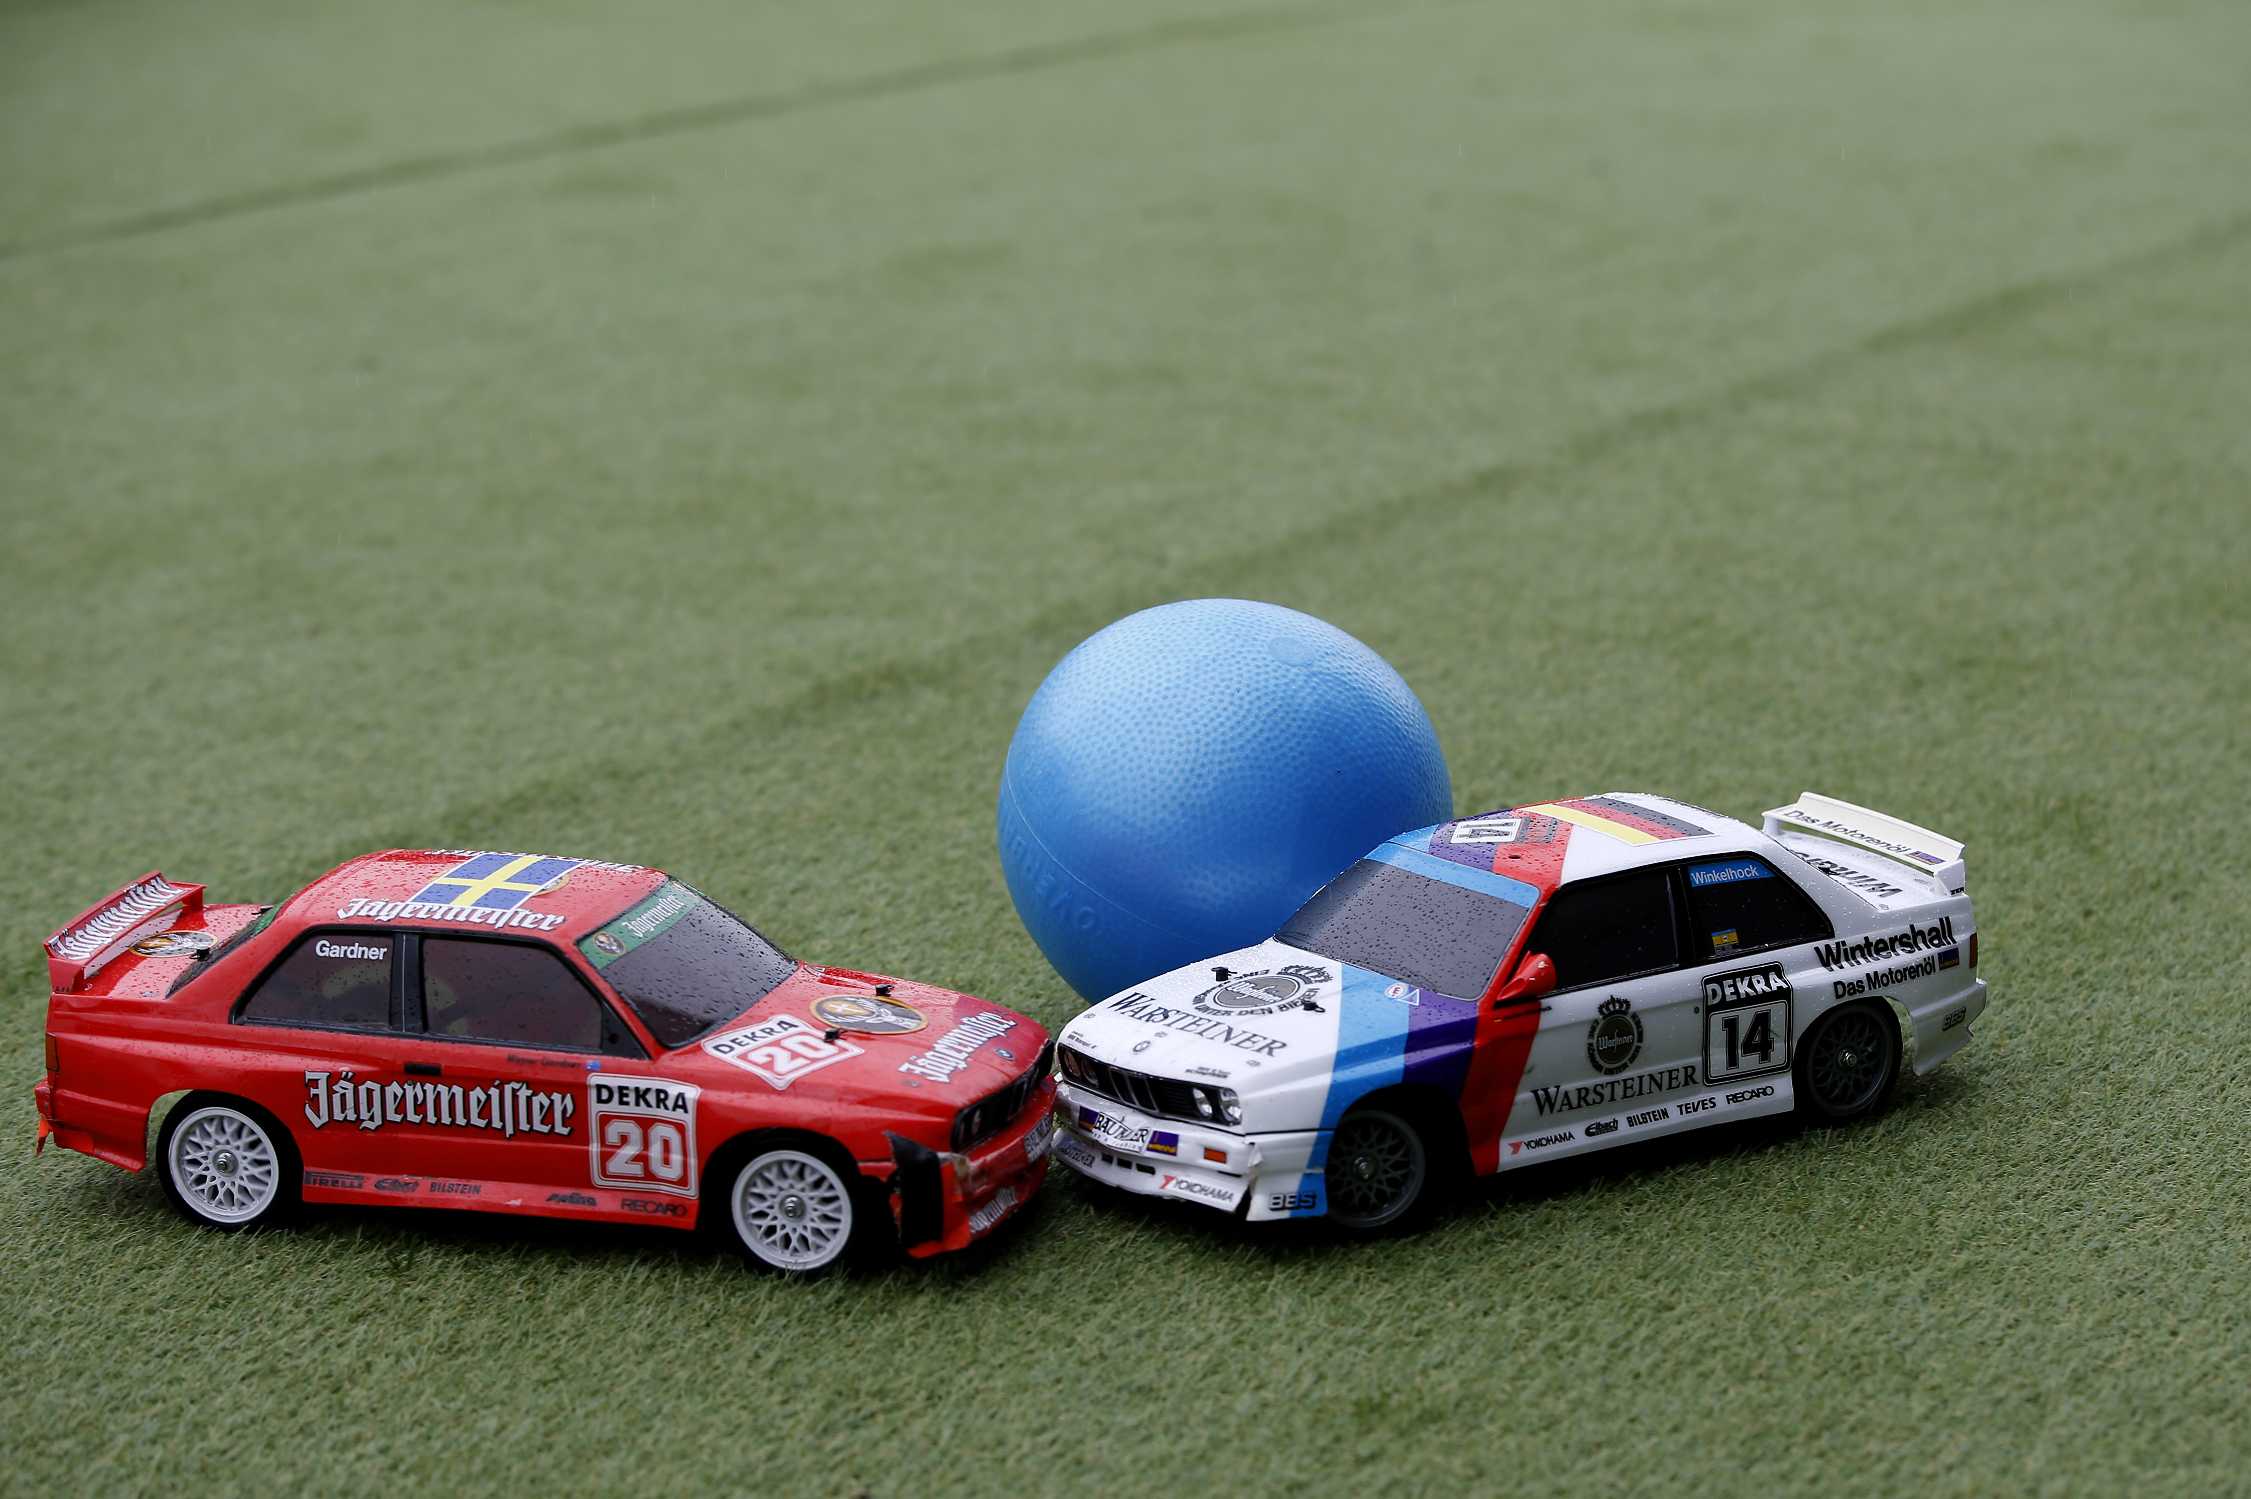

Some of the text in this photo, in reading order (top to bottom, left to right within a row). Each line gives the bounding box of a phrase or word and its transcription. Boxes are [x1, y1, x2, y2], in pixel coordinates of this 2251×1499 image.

[1691, 864, 1760, 886] Winkelhock
[315, 939, 388, 961] Gardner
[1813, 916, 1958, 972] Wintershall
[1706, 971, 1790, 1006] DEKRA
[1833, 979, 1866, 1000] Das
[1866, 955, 1937, 990] Motorenöl
[712, 1019, 800, 1055] DEKRA
[1106, 991, 1290, 1057] WARSTEINER
[1721, 1009, 1775, 1071] 14
[746, 1036, 846, 1075] 20
[594, 1083, 690, 1115] DEKRA
[1530, 1064, 1701, 1118] WARSTEINER
[1523, 1131, 1575, 1150] YOKOHAMA
[1626, 1107, 1669, 1128] BILSTEIN
[1677, 1097, 1717, 1116] TEVES
[1725, 1085, 1775, 1105] RECARO
[604, 1118, 684, 1182] 20
[429, 1181, 482, 1195] BILSTEIN
[620, 1198, 688, 1217] RECARO
[1171, 1176, 1235, 1203] YOKOHAMA
[1268, 1191, 1317, 1212] BBS
